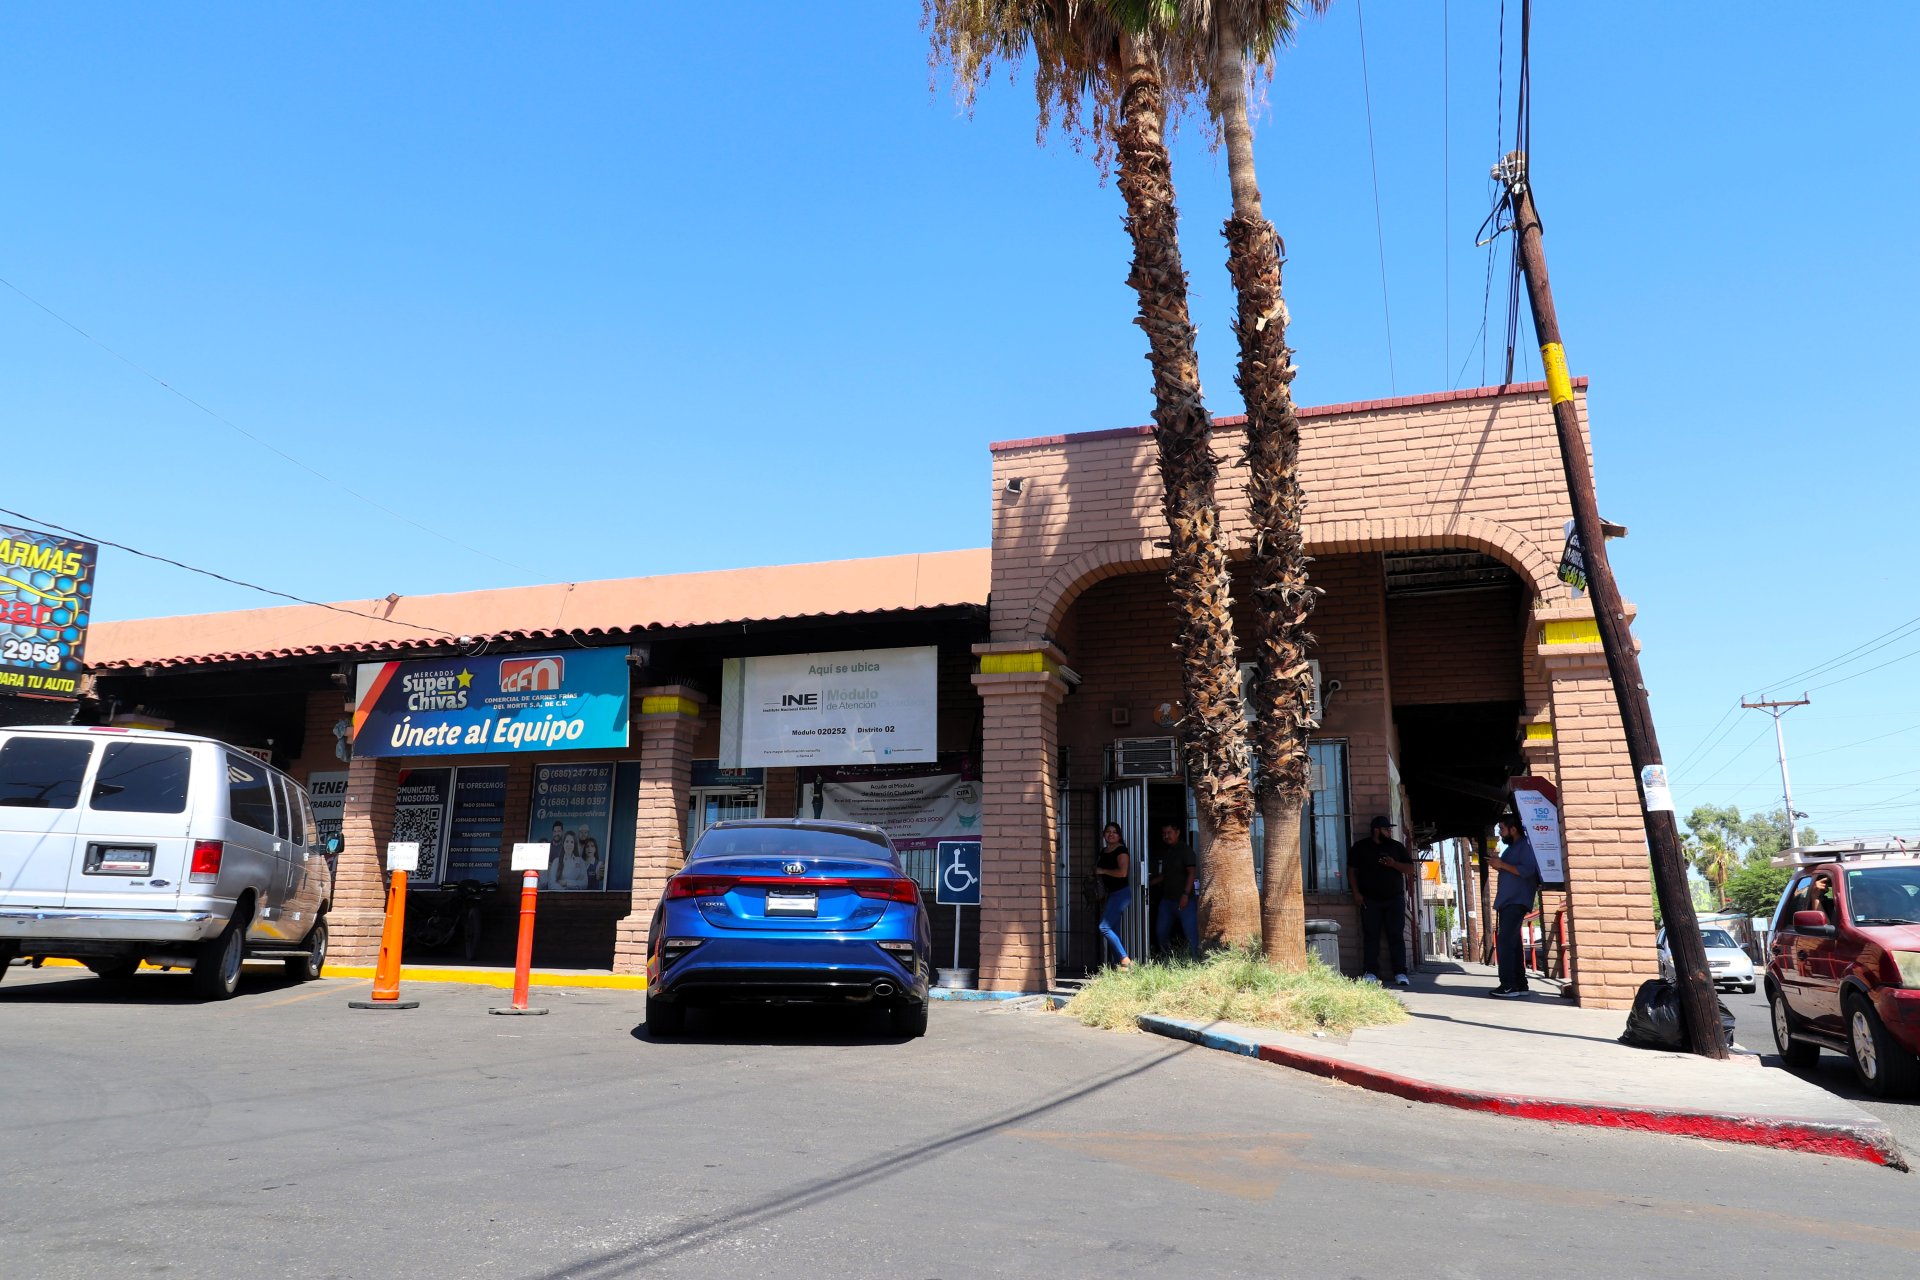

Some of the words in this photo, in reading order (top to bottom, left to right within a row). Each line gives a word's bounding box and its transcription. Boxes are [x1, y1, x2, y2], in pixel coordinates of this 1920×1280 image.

[3, 639, 60, 664] 2958
[413, 669, 455, 678] MERCADOS
[808, 664, 833, 677] Aquí
[835, 665, 848, 674] se
[850, 662, 880, 673] ubica
[28, 675, 43, 688] TU
[43, 677, 75, 692] AUTO
[402, 674, 455, 695] Super
[484, 695, 520, 704] COMERCIAL
[521, 695, 531, 703] DE
[531, 694, 557, 702] CARNES
[558, 692, 578, 700] FRÍAS
[782, 693, 818, 707] INE
[827, 687, 879, 701] Módulo
[826, 702, 838, 711] de
[838, 700, 877, 710] Atención
[390, 715, 462, 748] Únete
[464, 718, 491, 745] al
[493, 714, 585, 748] Equipo
[817, 727, 847, 736] 020252
[884, 725, 895, 733] 02
[466, 781, 506, 789] OFRECEMOS:
[402, 794, 440, 803] NOSOTROS
[1533, 807, 1550, 815] 150
[786, 864, 802, 873] KIA
